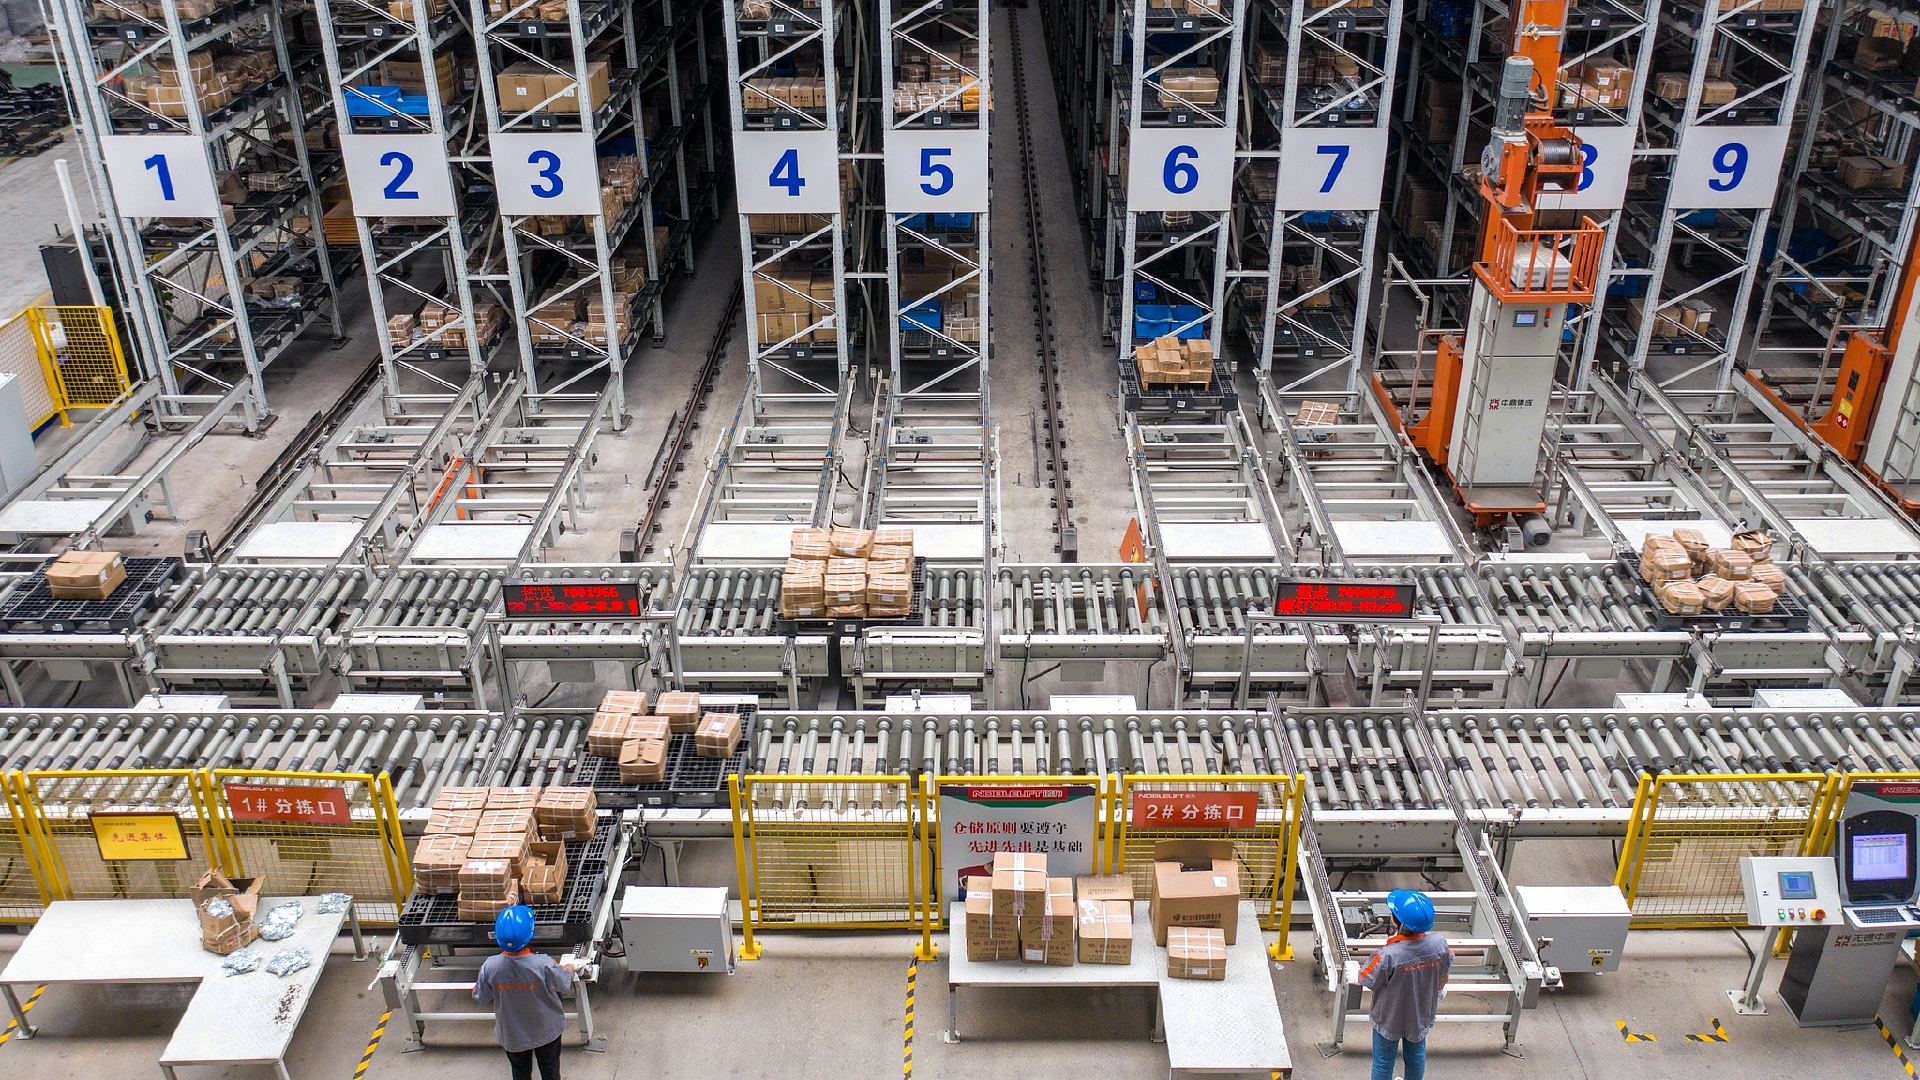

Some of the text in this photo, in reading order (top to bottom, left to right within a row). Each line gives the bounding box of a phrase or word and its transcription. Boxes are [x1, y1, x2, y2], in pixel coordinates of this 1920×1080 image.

[144, 153, 176, 201] 1
[380, 151, 419, 200] 2
[527, 151, 564, 199] 3
[768, 149, 806, 197] 4
[919, 148, 954, 196] 5
[1162, 145, 1200, 195] 6
[1316, 145, 1349, 193] 7
[1708, 143, 1749, 192] 9
[242, 797, 337, 816] 1# 分拣口
[972, 789, 1043, 798] NOBLELIFT
[1146, 803, 1244, 820] 2# 分拣口
[112, 832, 168, 843] 先进集体
[952, 821, 1068, 835] 仓储原则要遵守
[967, 840, 1083, 853] 先进先出是基础
